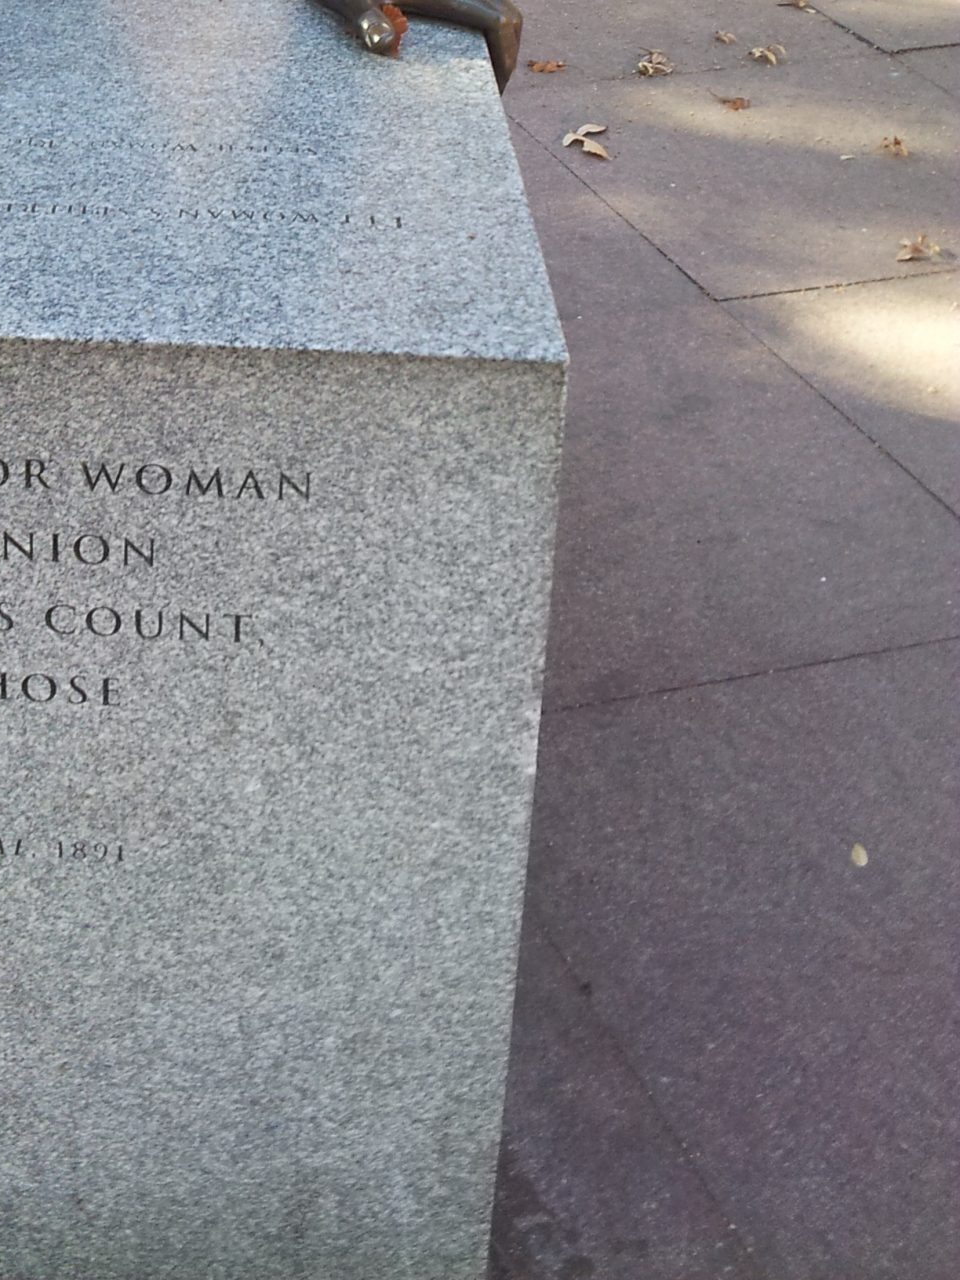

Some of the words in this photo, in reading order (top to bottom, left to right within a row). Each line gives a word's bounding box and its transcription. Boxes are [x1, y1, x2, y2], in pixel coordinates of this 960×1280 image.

[80, 461, 312, 502] WOMAN
[45, 603, 264, 648] COUNT,
[56, 839, 126, 863] 1891
